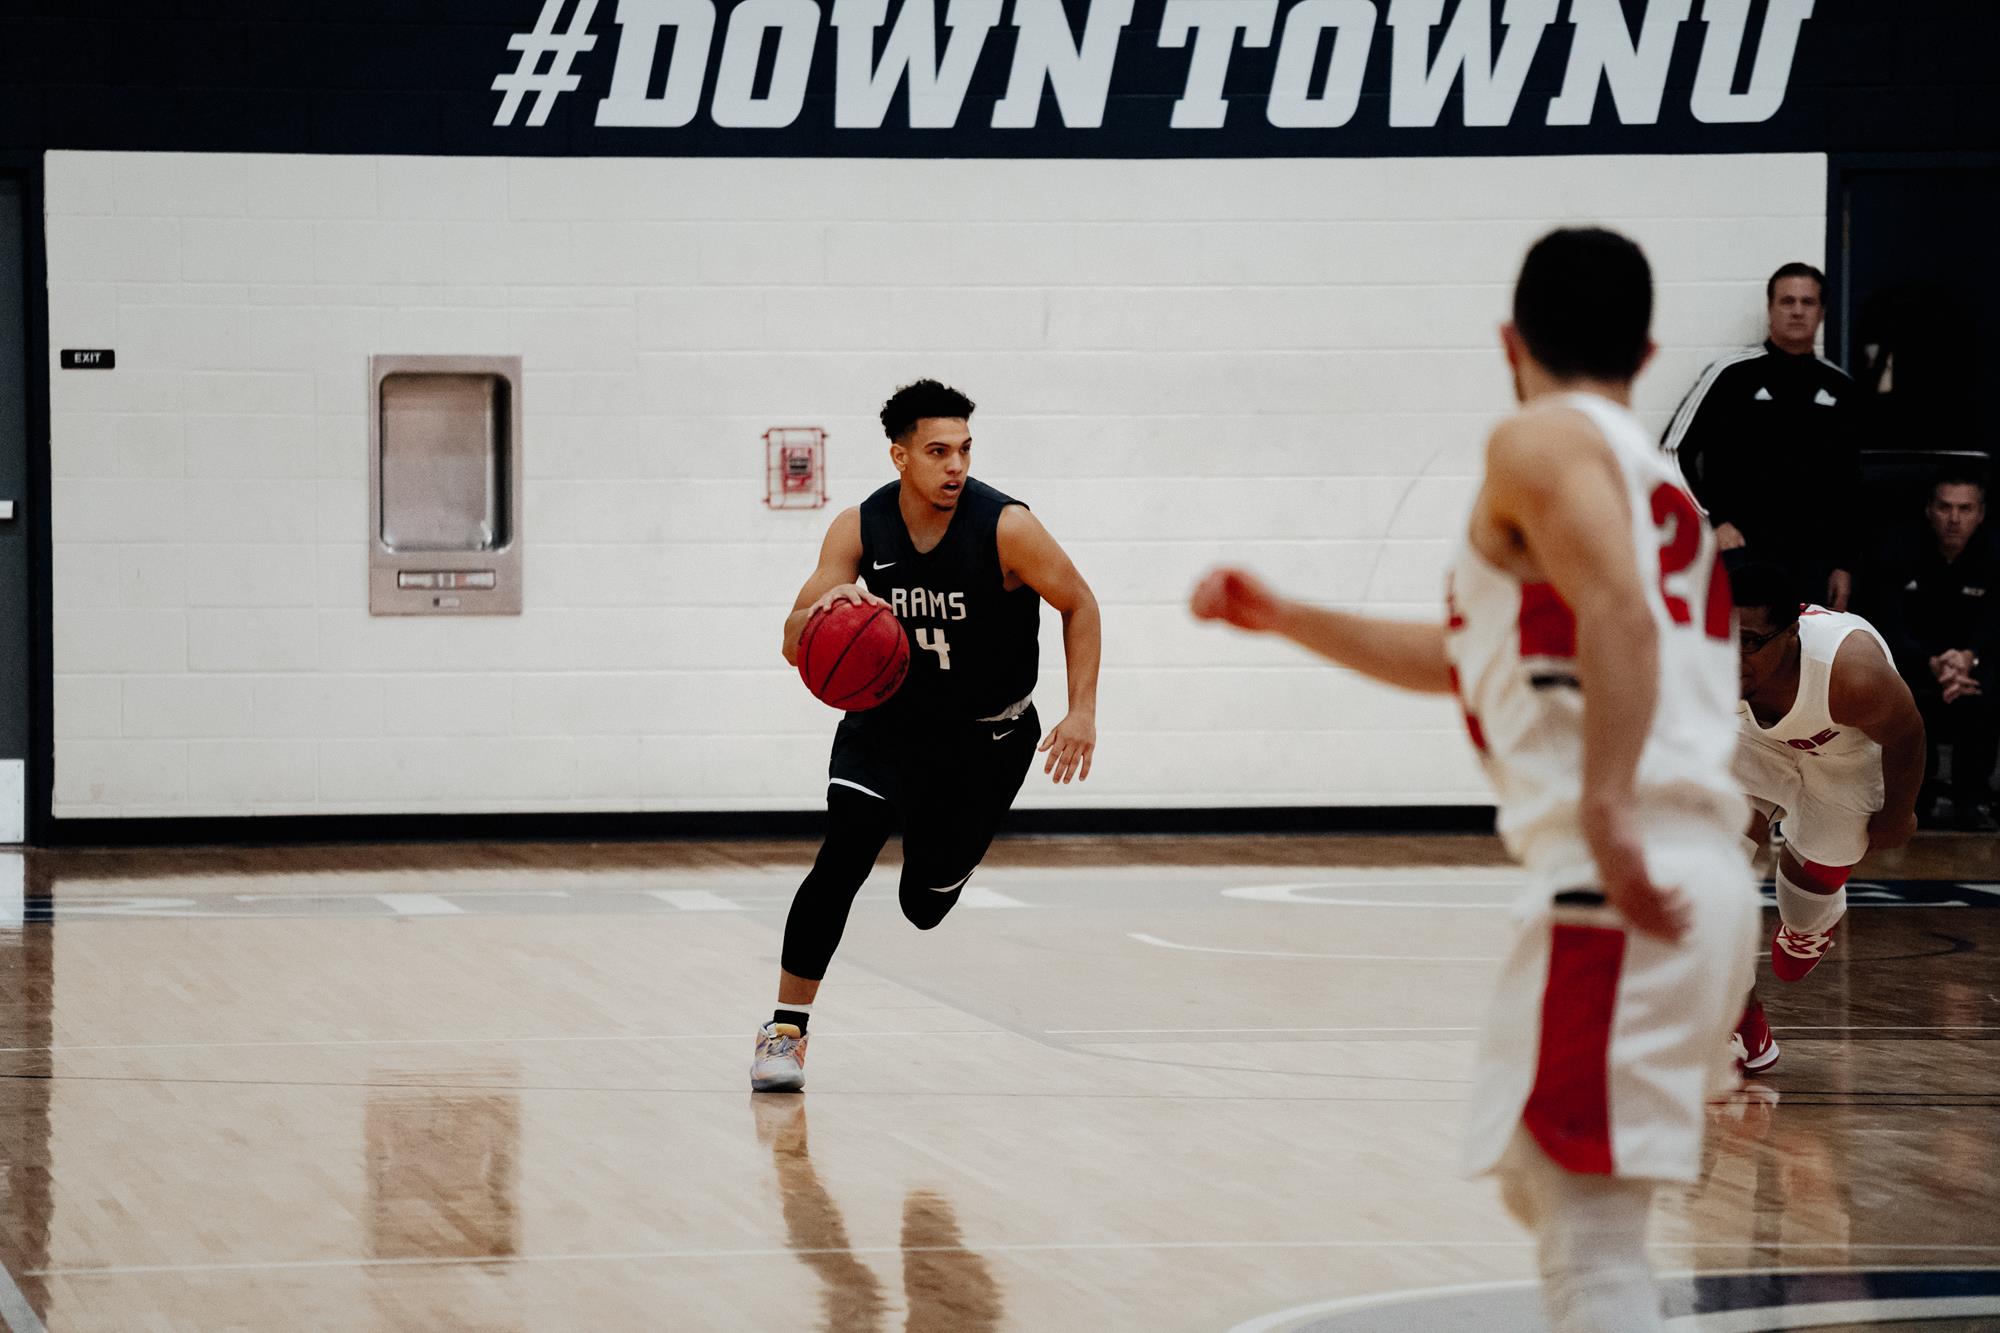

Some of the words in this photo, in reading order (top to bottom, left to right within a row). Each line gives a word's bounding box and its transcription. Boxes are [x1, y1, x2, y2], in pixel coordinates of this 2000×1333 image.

[74, 352, 101, 363] EXIT
[891, 587, 967, 621] RAMS
[915, 628, 951, 670] 4
